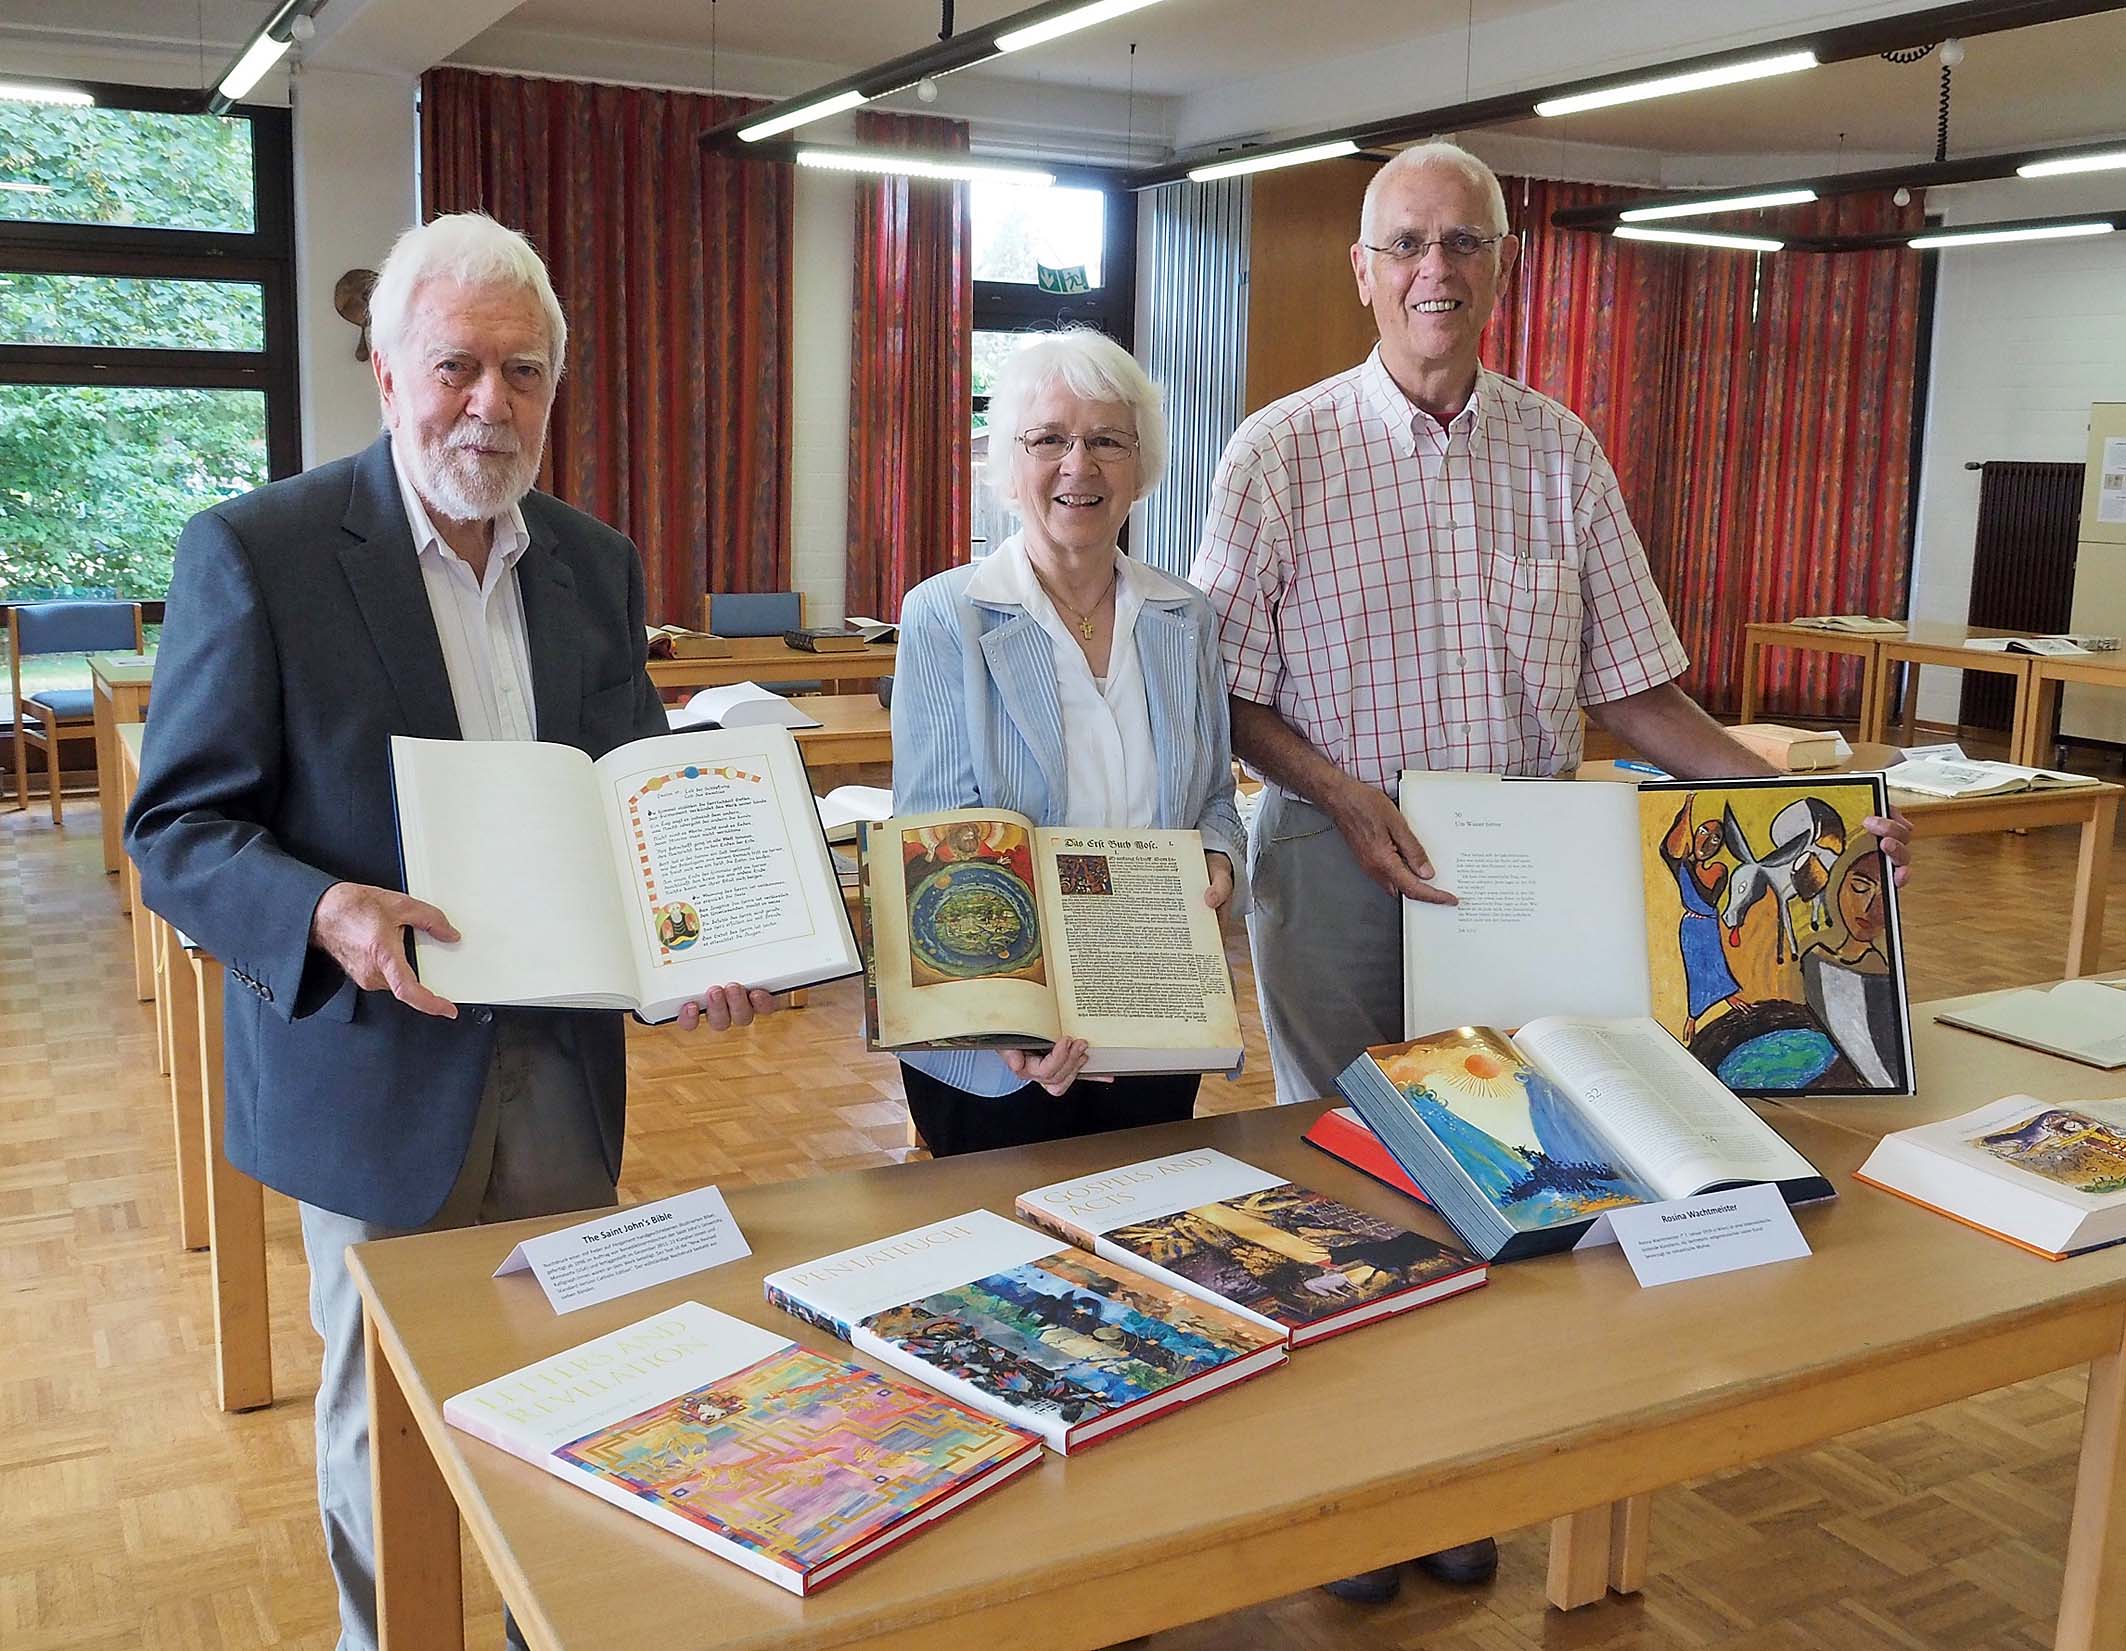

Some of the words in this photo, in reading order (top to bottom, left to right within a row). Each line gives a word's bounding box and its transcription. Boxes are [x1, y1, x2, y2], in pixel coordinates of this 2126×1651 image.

[1158, 1156, 1213, 1176] AND
[1661, 1208, 1687, 1223] Rosina
[1687, 1203, 1738, 1218] Wachtmeister
[582, 1235, 600, 1244] The
[600, 1227, 623, 1239] Saint
[624, 1219, 651, 1232] John's
[650, 1213, 672, 1224] Bible
